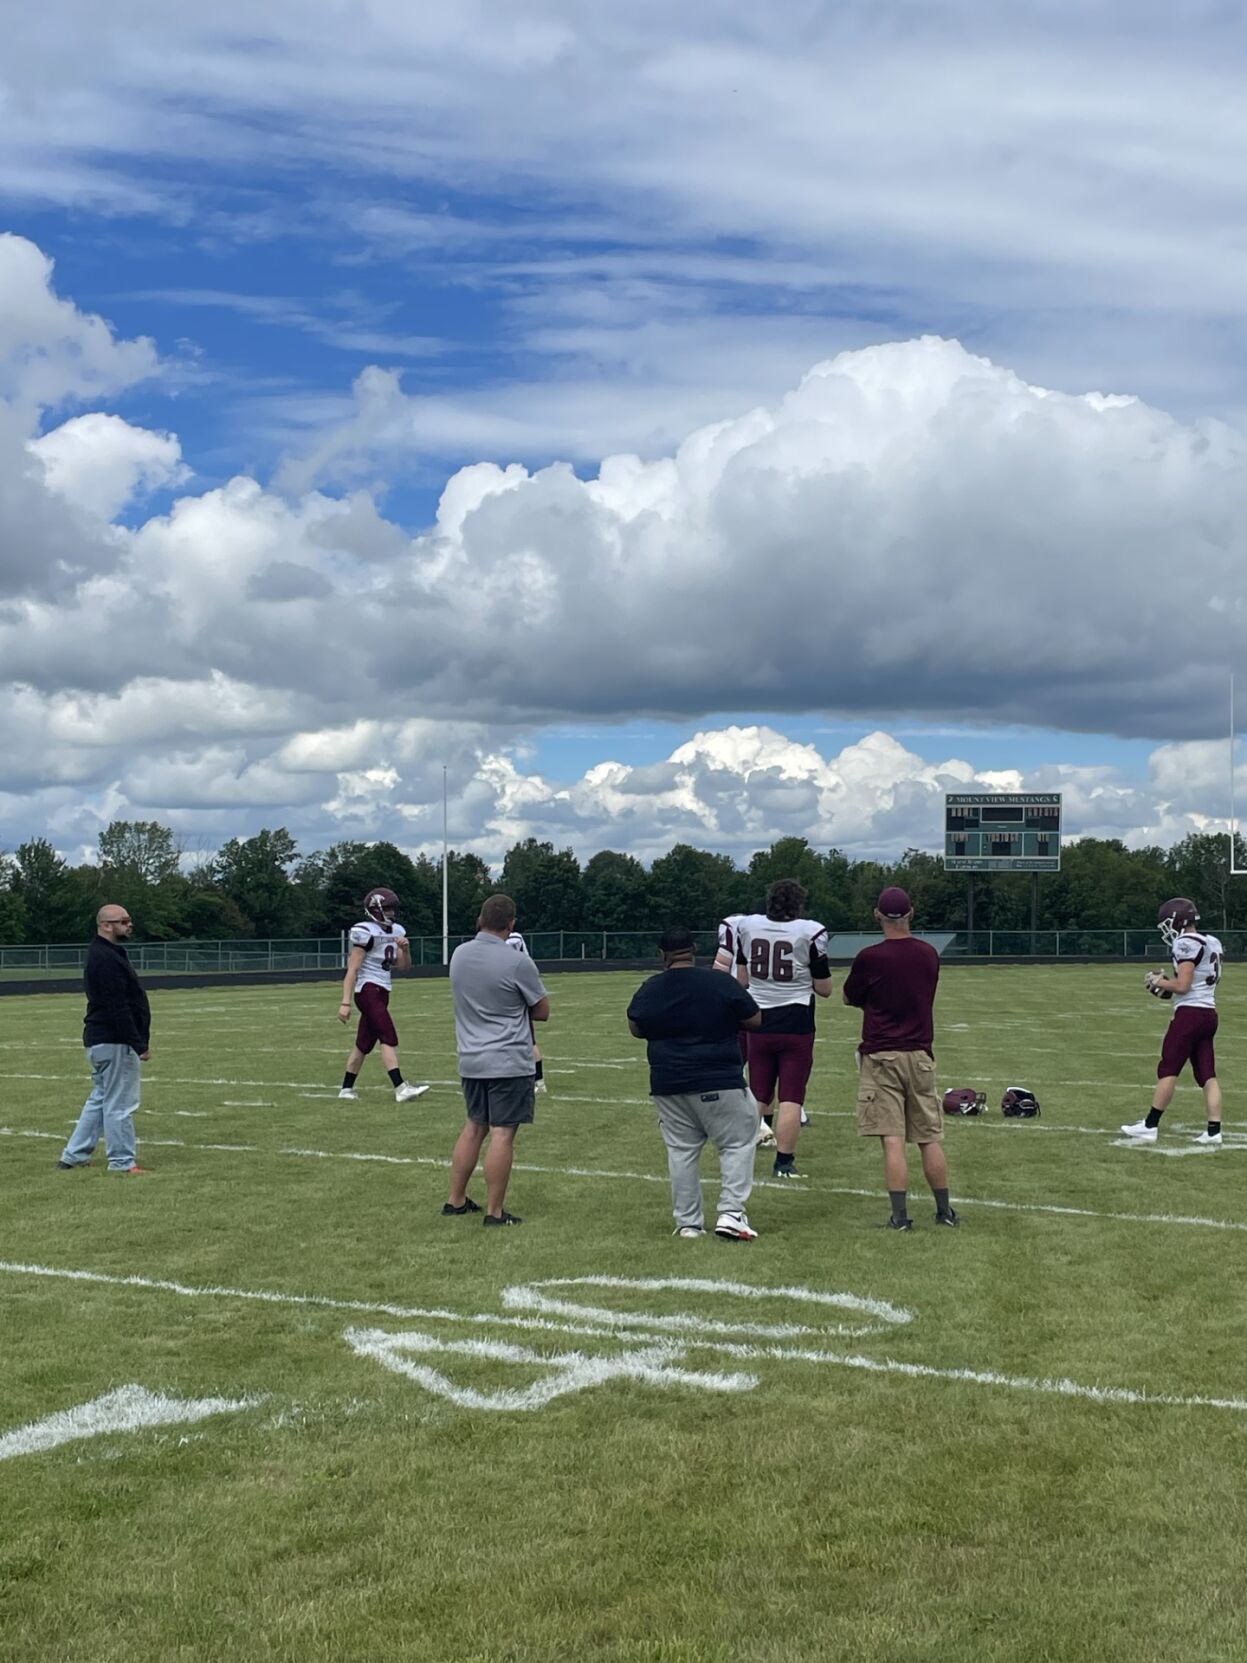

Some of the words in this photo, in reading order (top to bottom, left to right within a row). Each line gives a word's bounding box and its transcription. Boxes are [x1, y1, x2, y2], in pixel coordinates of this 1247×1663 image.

[956, 795, 984, 803] MOUNT
[985, 795, 1006, 803] VIEW
[1008, 795, 1051, 803] MUSTANGS
[751, 938, 793, 982] 86
